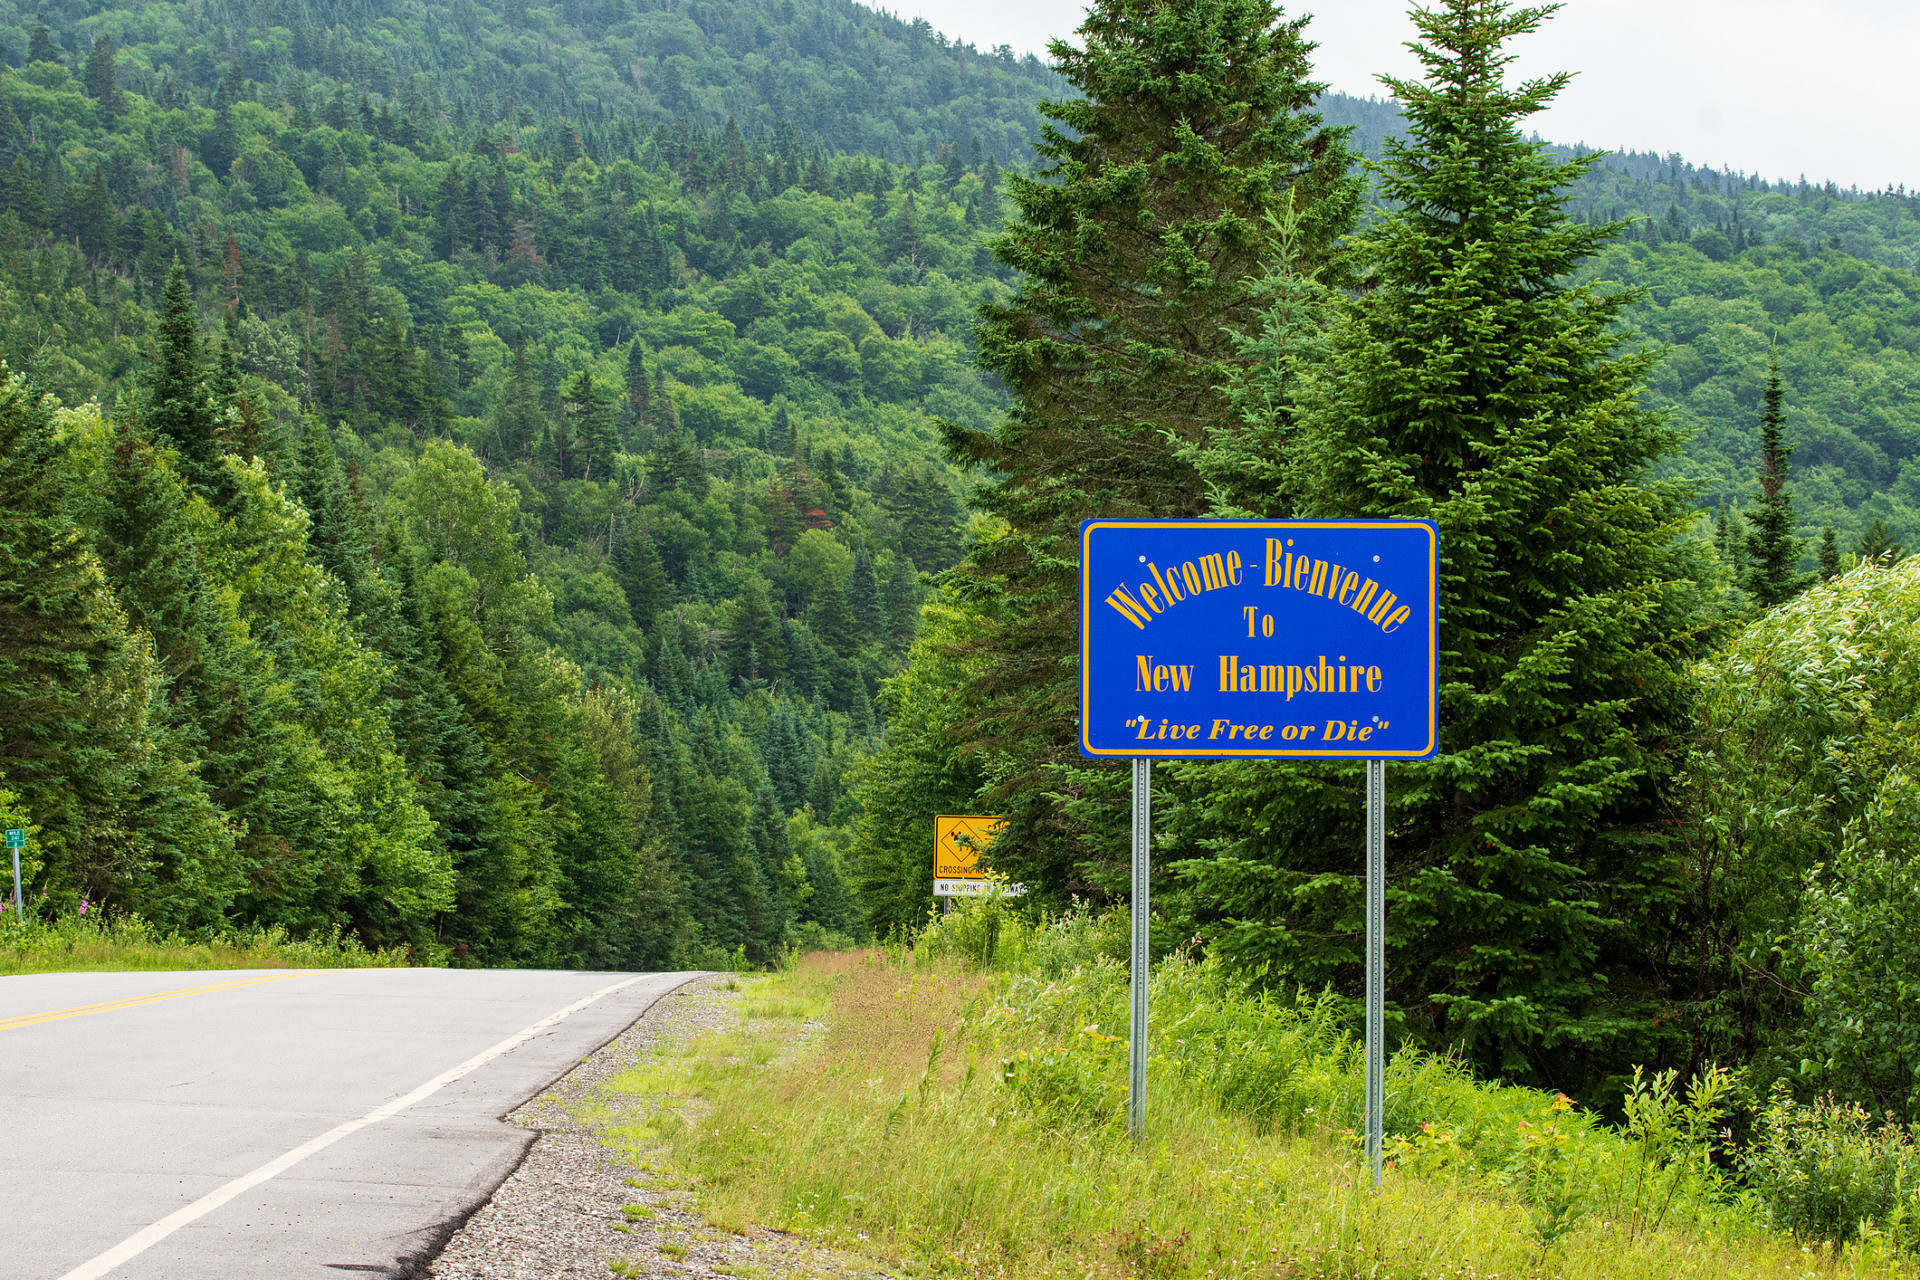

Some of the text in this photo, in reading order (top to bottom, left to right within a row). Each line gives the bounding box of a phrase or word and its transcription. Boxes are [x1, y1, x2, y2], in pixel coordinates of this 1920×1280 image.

[1104, 549, 1243, 631] Welcome
[1263, 537, 1411, 634] Bienvenue
[1243, 606, 1275, 638] To
[1135, 655, 1383, 702] New Hampshire
[1125, 719, 1390, 742] "Live Free or Die"
[940, 883, 949, 892] NO
